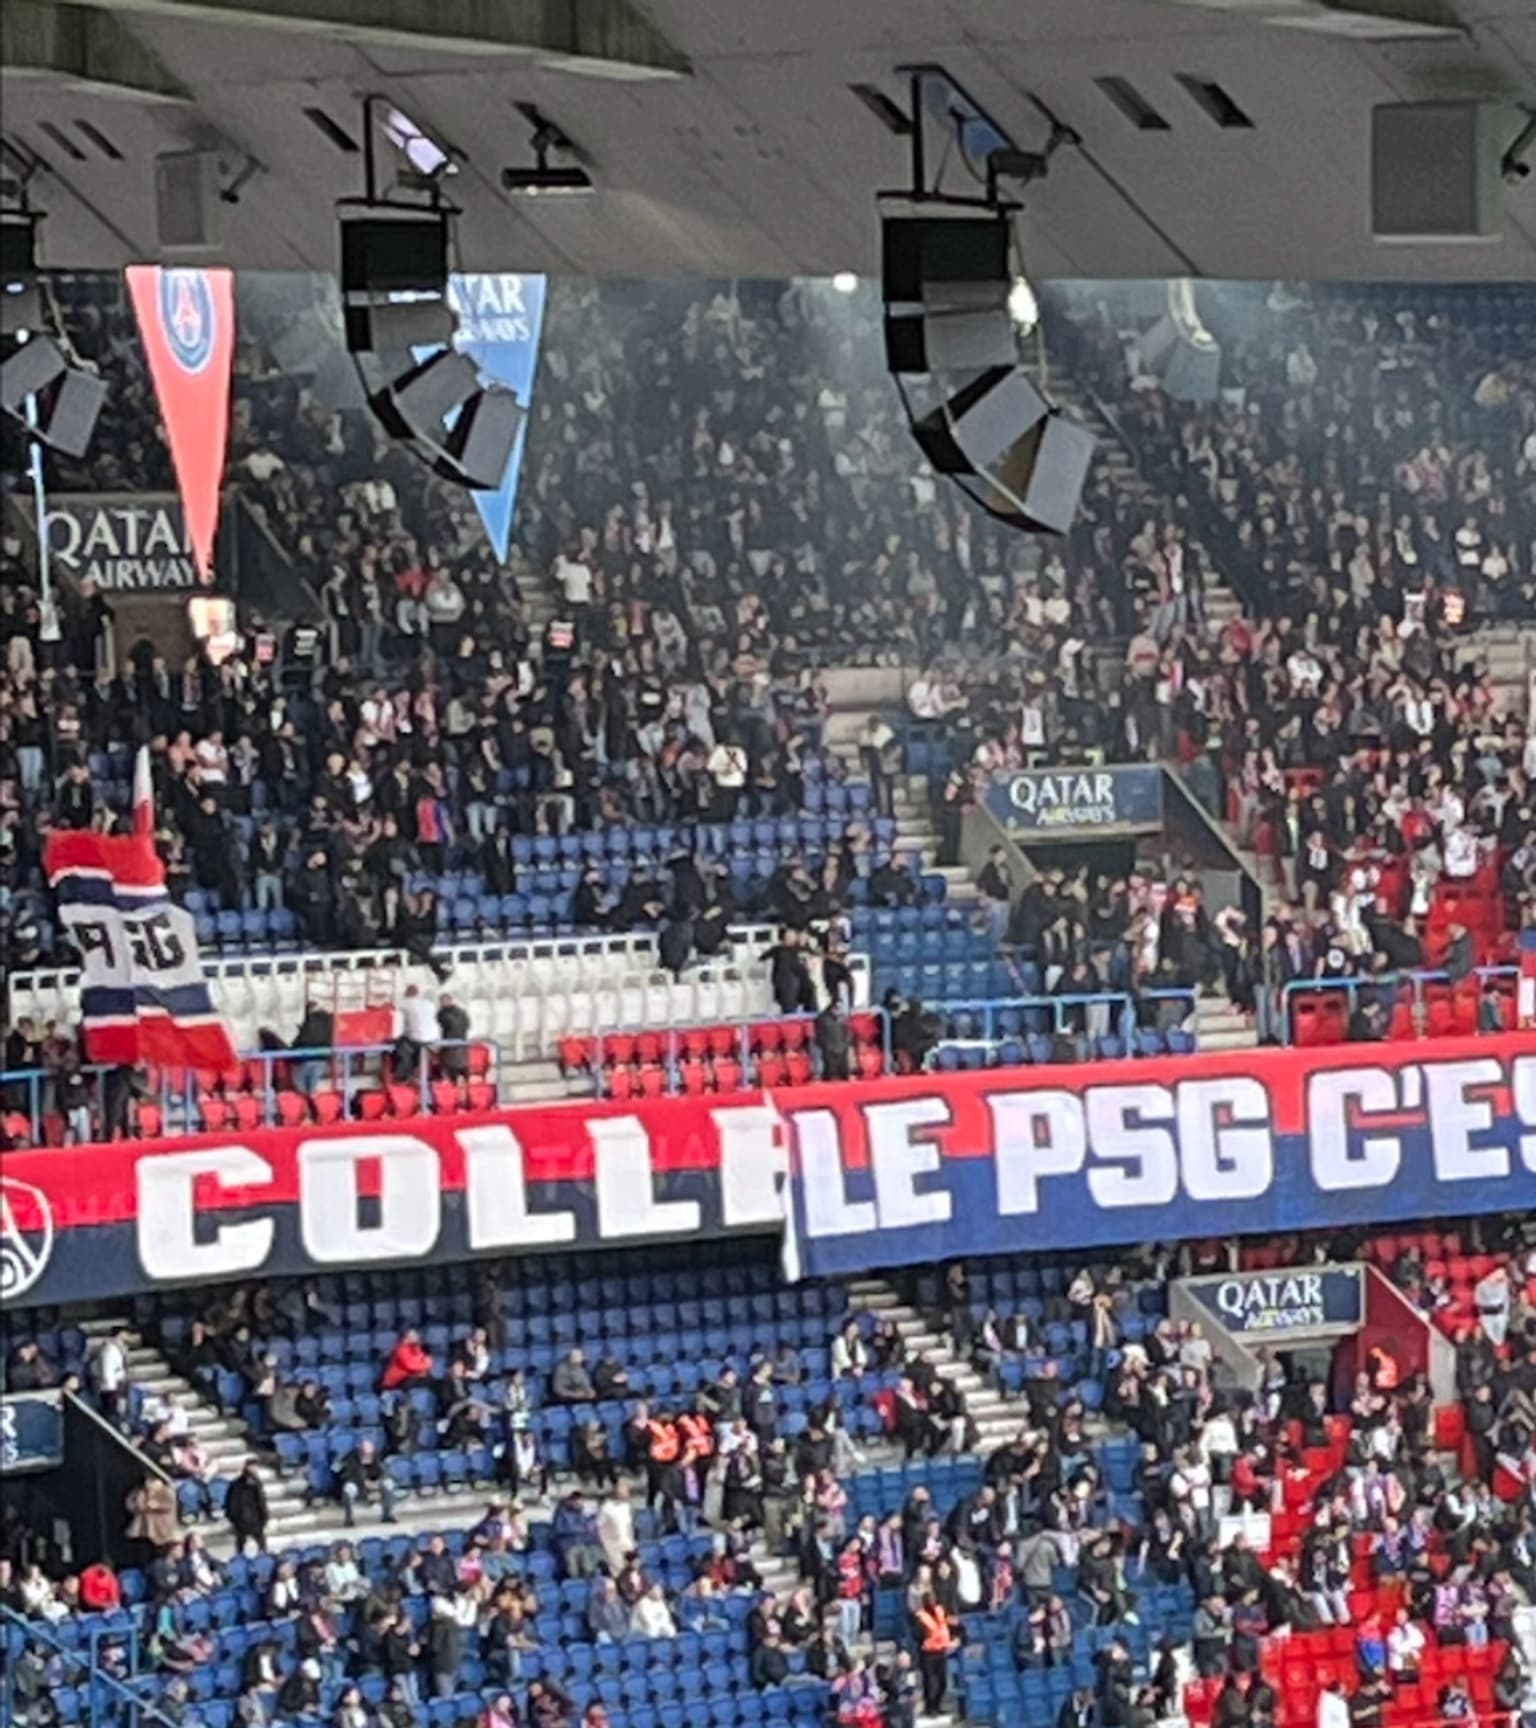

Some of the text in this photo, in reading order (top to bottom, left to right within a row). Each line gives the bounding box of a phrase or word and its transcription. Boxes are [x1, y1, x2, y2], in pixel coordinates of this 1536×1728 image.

[1010, 774, 1115, 813] QATAR
[791, 1098, 952, 1237] LE
[986, 1076, 1273, 1215] PSG
[1217, 1274, 1323, 1318] QATAR
